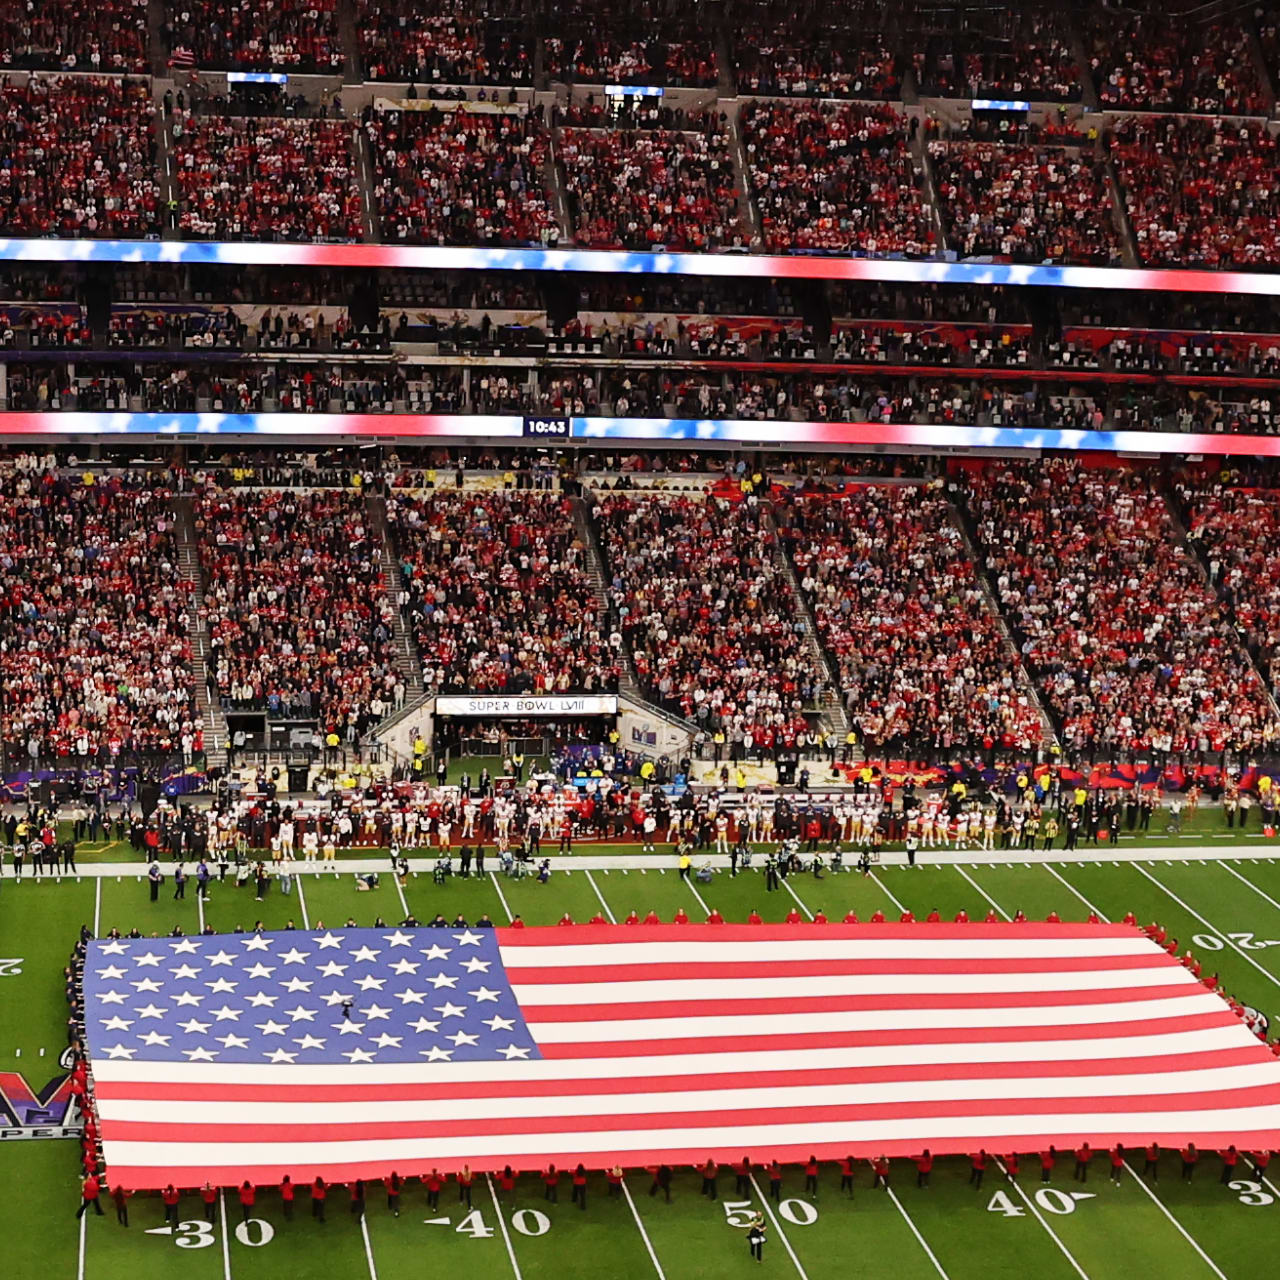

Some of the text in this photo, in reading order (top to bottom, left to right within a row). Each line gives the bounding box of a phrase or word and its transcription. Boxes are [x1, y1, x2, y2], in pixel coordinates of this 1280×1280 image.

[527, 420, 566, 434] 10:43
[469, 699, 585, 712] SUPER BOWL LVIII
[722, 1197, 819, 1228] 50
[986, 1187, 1077, 1218] 40
[174, 1217, 275, 1248] 30
[454, 1208, 552, 1238] 40
